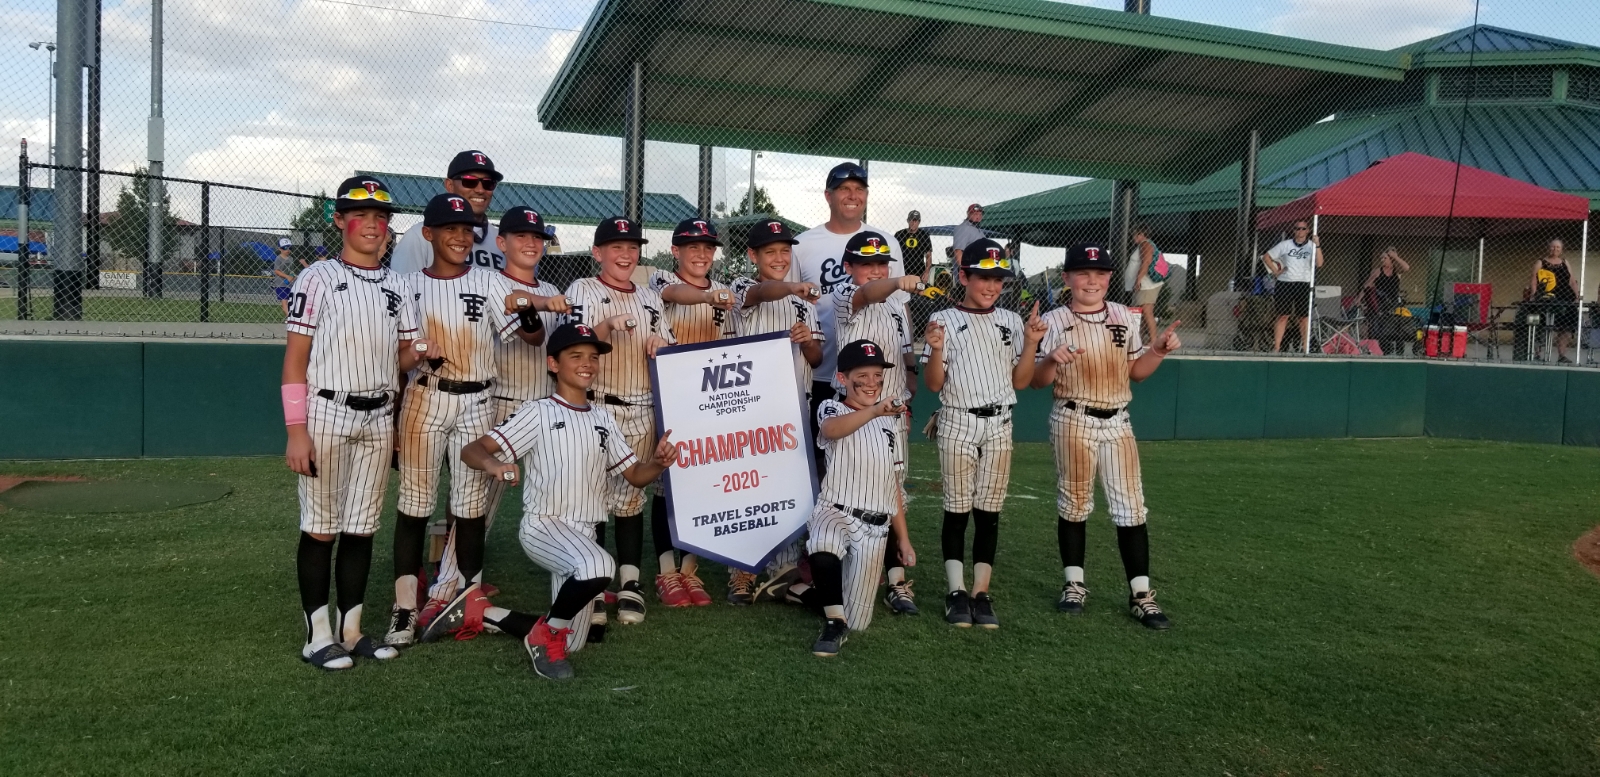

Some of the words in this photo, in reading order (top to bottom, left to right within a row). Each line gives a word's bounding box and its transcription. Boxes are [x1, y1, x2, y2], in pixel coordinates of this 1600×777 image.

[701, 360, 753, 393] NCS
[698, 395, 761, 411] CHAMPIONSHIP
[708, 389, 750, 402] NATIONAL
[715, 405, 746, 416] SPORTS
[675, 422, 798, 469] CHAMPIONS
[692, 509, 742, 528] TRAVEL
[744, 499, 796, 518] SPORTS
[713, 515, 778, 537] BASEBALL
